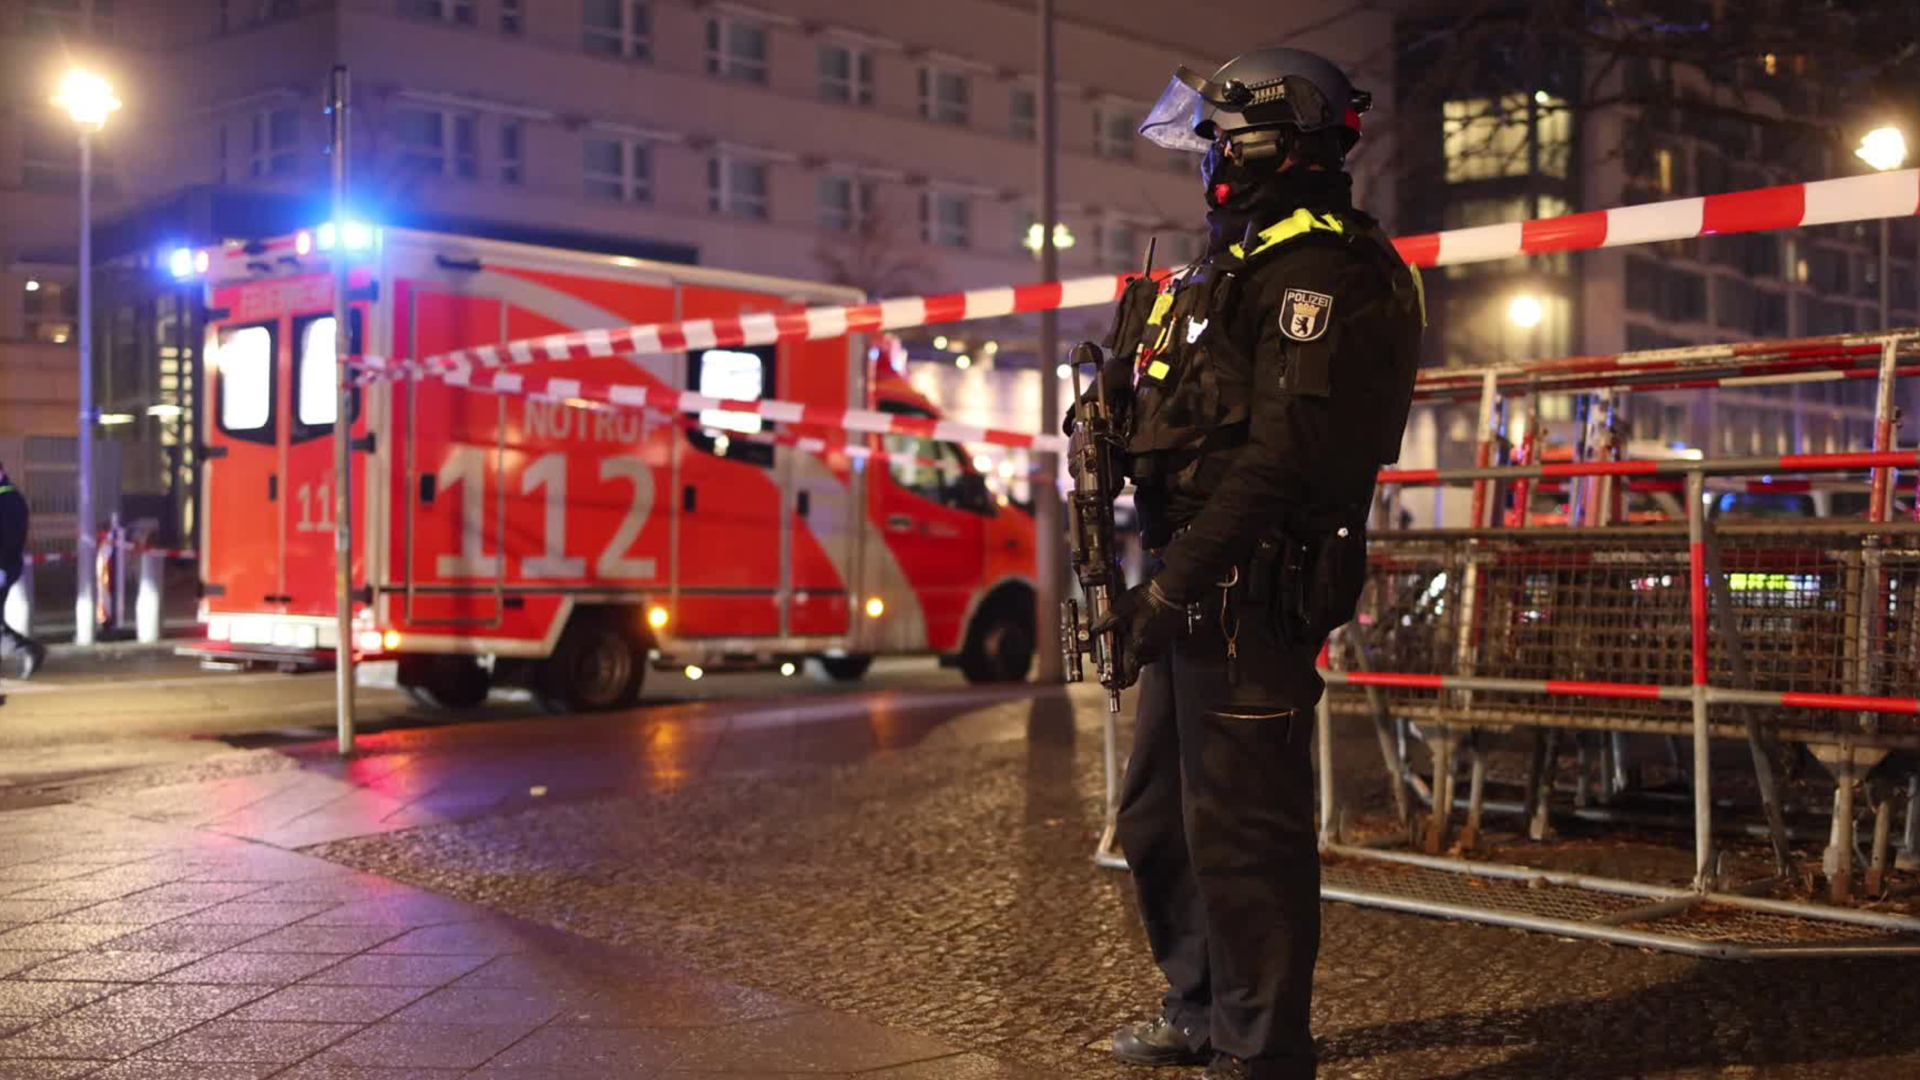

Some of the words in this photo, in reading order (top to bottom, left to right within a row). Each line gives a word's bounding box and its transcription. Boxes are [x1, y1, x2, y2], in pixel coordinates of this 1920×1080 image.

[1287, 292, 1328, 307] POLIZEI
[297, 483, 336, 531] 11
[436, 444, 656, 577] 112
